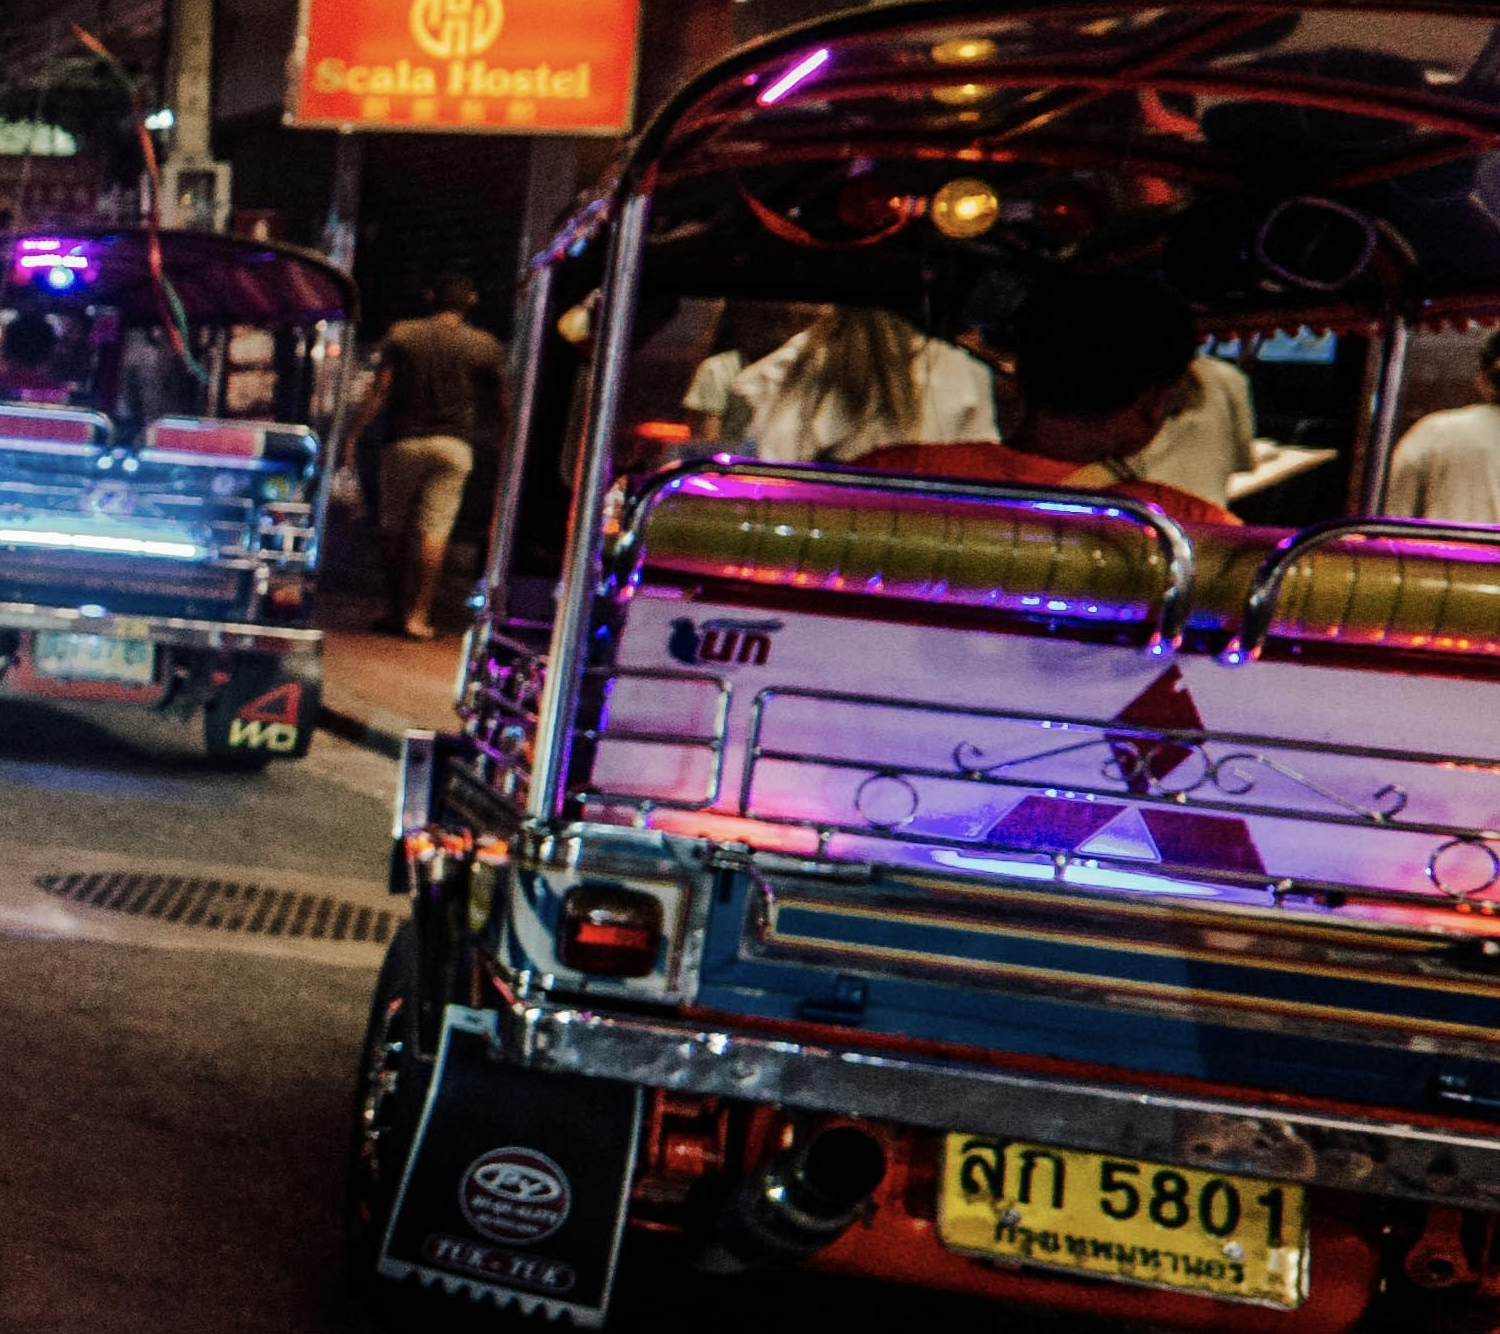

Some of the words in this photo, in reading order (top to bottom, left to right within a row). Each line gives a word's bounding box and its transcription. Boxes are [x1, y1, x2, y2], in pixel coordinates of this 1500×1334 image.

[314, 57, 436, 97] Scala
[447, 59, 593, 99] Hostel
[239, 683, 299, 726] 4
[228, 718, 298, 752] WD
[1100, 1160, 1285, 1248] 5801
